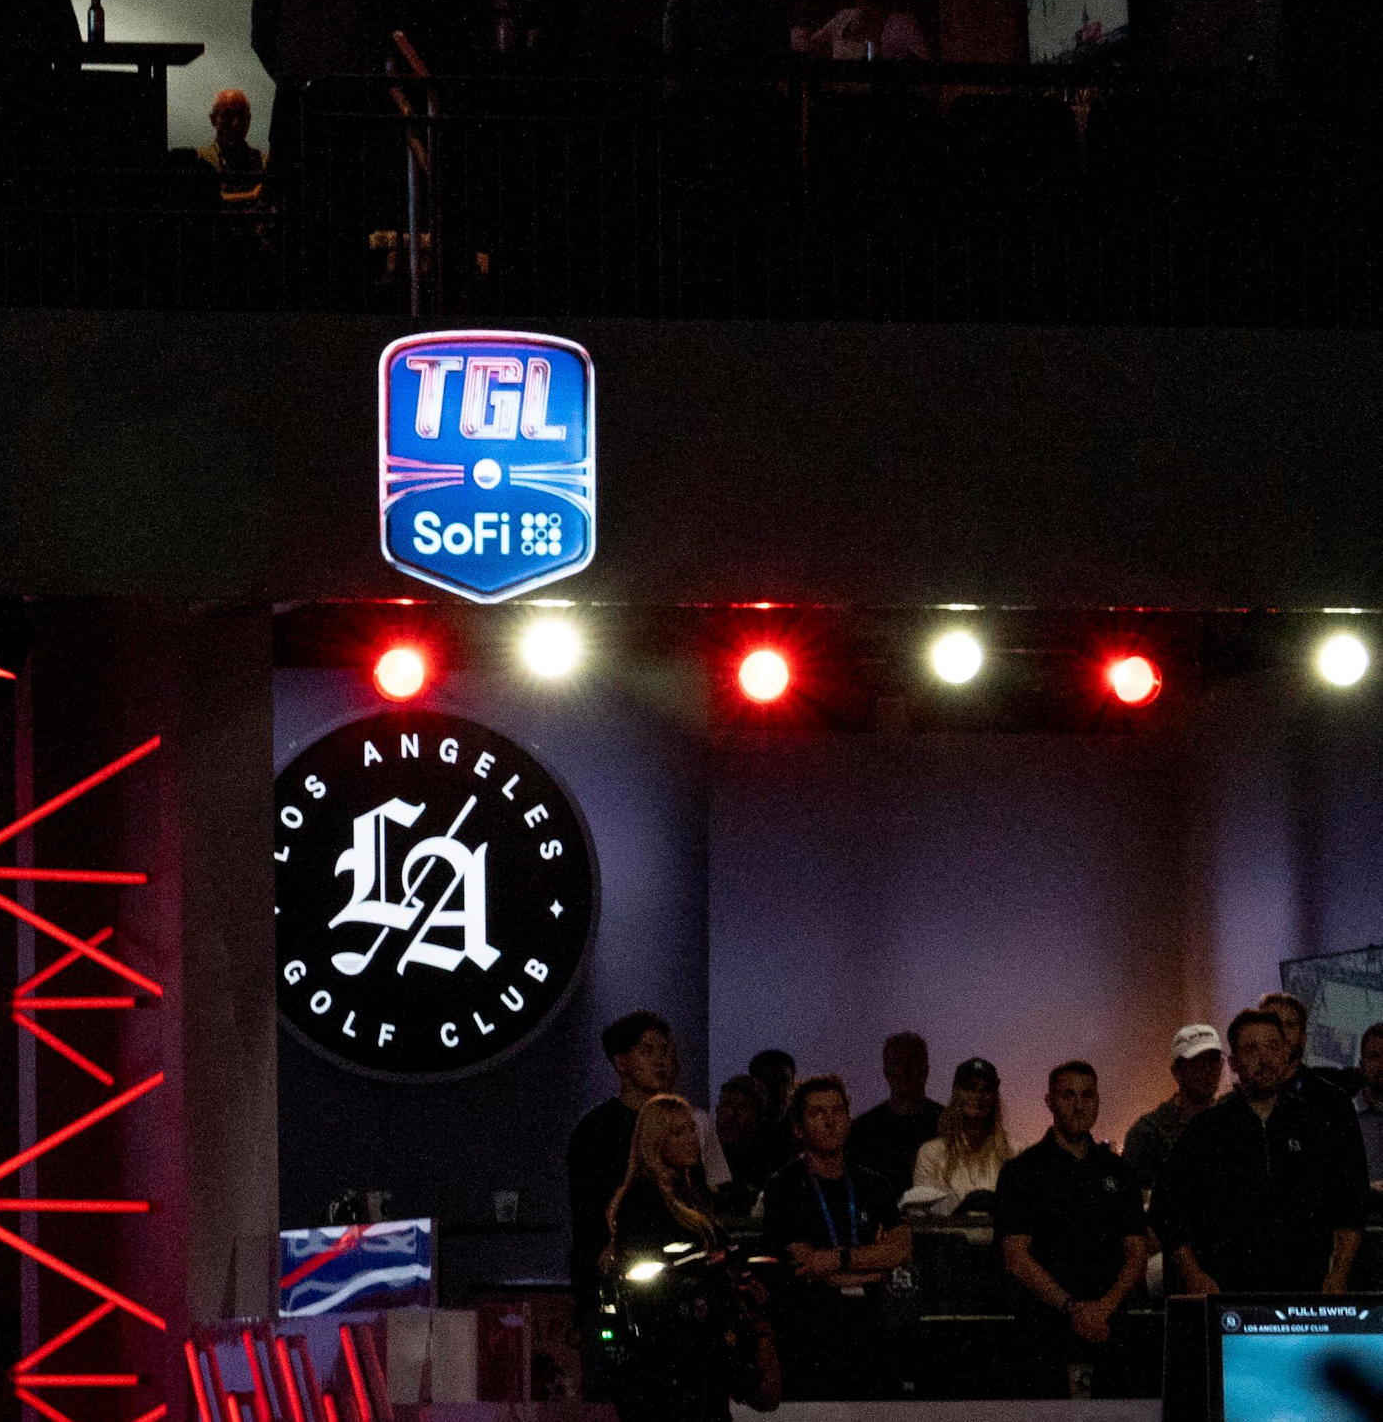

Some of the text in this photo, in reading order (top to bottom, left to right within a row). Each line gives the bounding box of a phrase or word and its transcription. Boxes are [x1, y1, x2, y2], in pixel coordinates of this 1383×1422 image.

[406, 356, 567, 441] TGL
[413, 510, 510, 556] SoFi
[274, 733, 564, 863] LOS ANGELES
[283, 957, 550, 1048] GOLF CLUB
[1258, 1324, 1290, 1333] ANGELES
[1288, 1306, 1318, 1317] FULL
